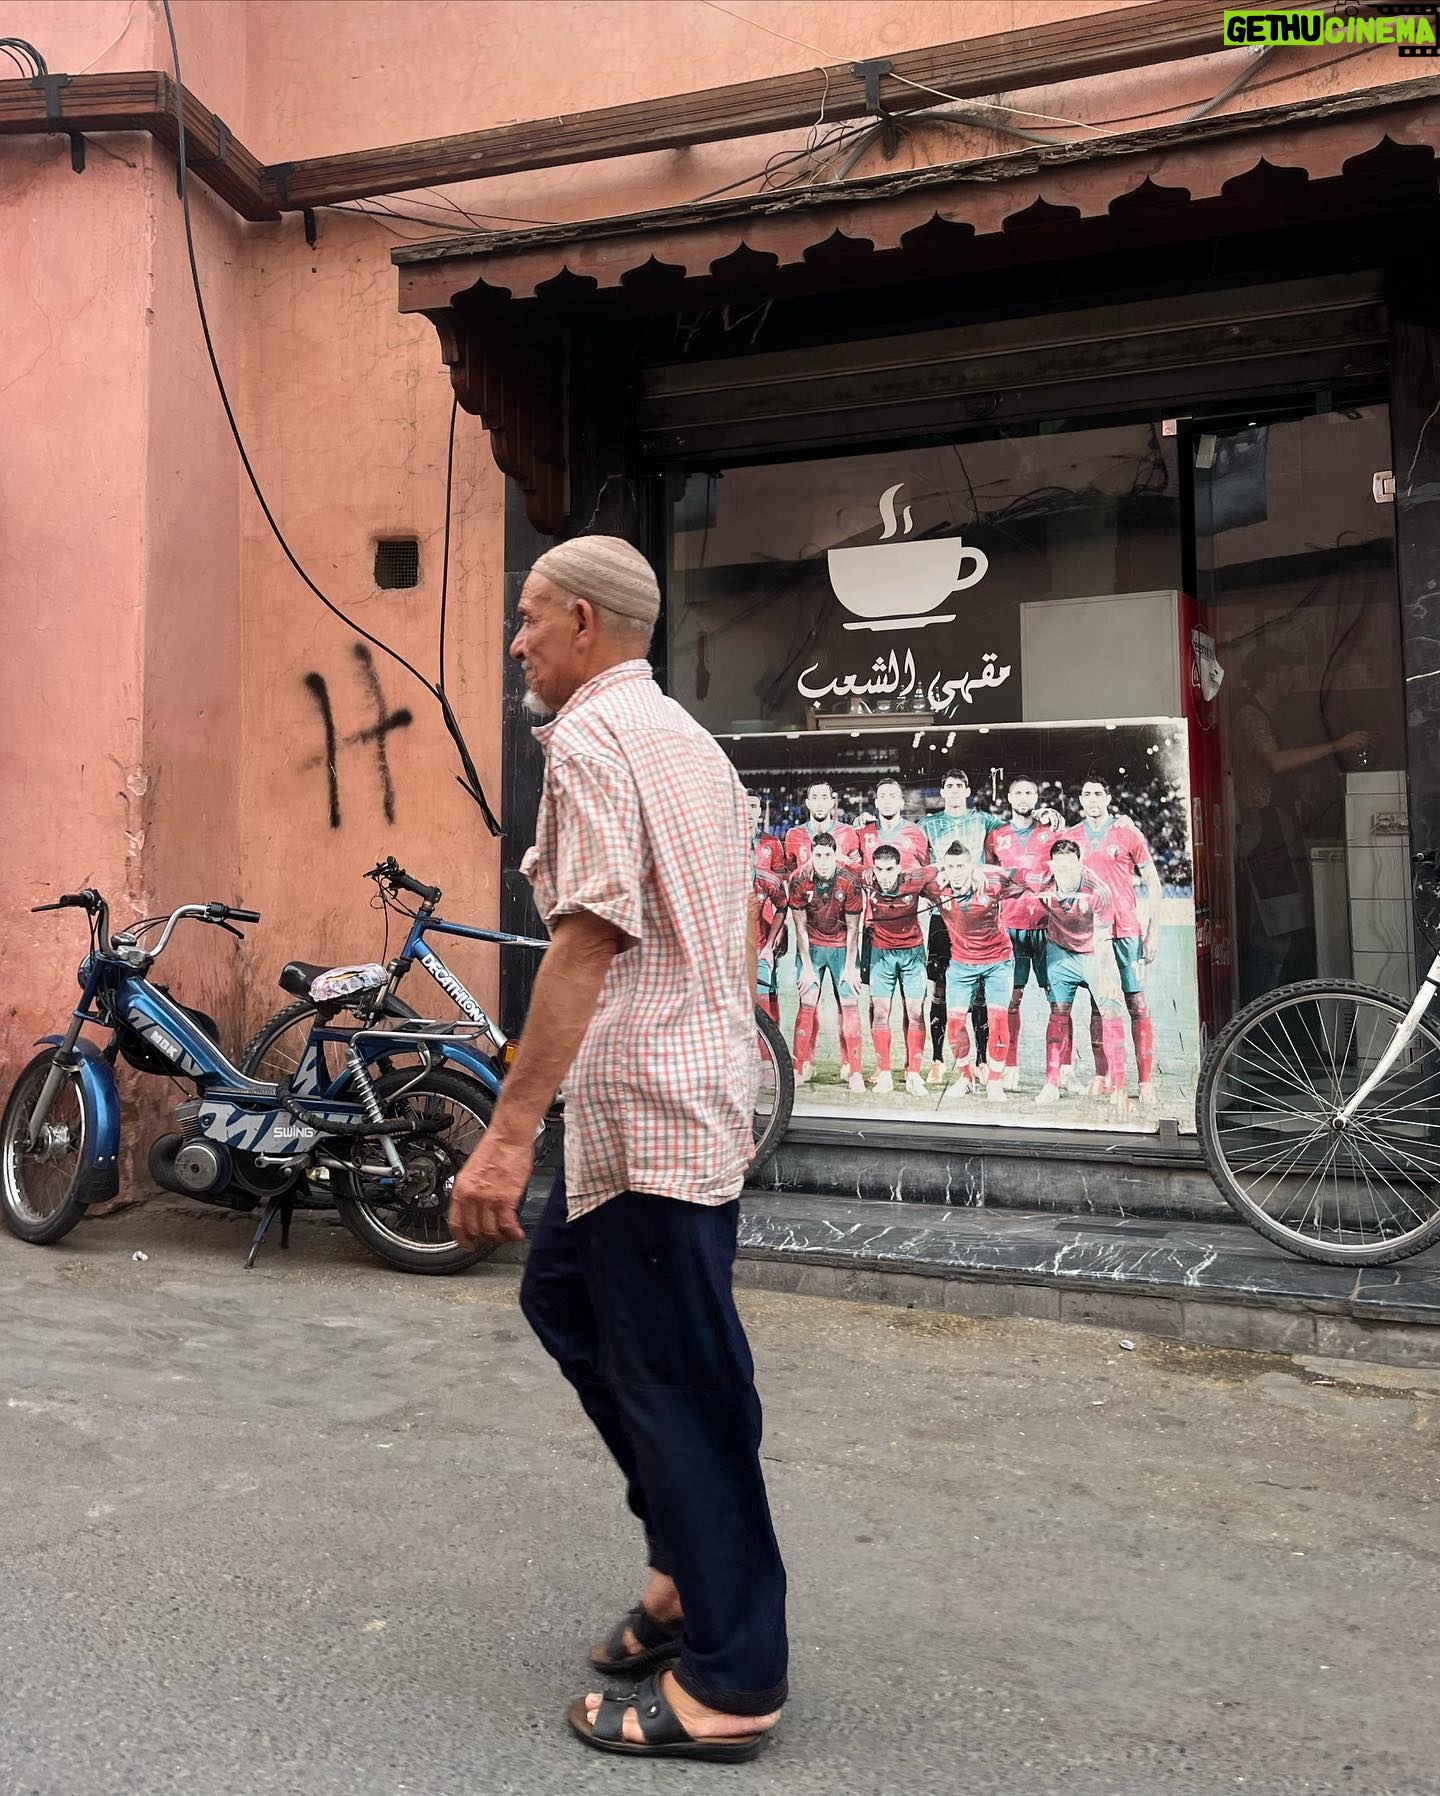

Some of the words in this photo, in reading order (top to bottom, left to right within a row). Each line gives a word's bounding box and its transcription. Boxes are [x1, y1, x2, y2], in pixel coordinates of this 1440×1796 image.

[797, 648, 916, 708] الشعب
[806, 890, 815, 903] 7
[421, 953, 486, 1023] DECATHLON
